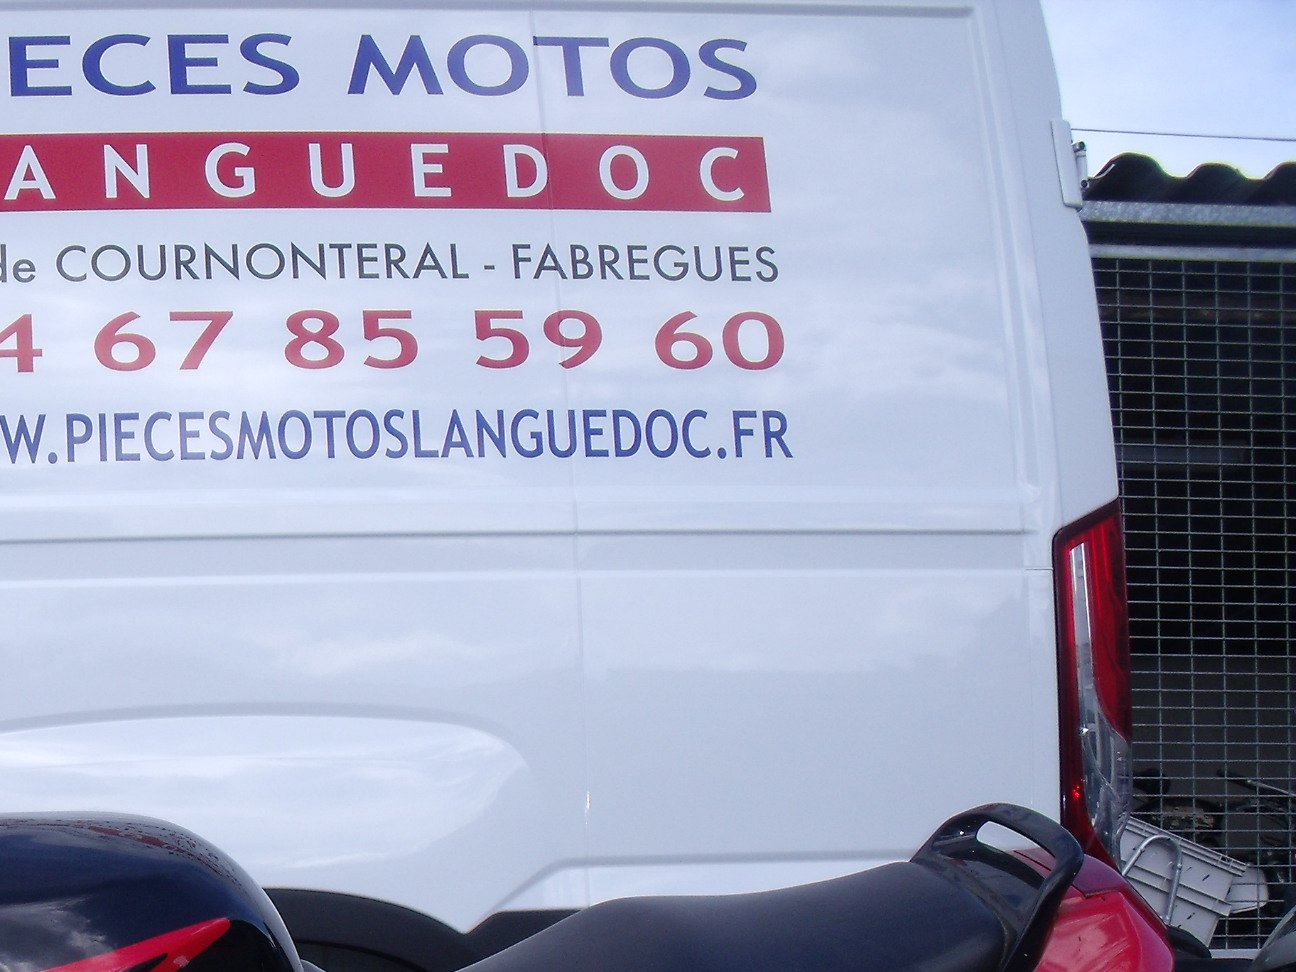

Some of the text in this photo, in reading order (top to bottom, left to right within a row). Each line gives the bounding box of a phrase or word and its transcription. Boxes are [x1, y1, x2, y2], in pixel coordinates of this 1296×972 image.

[348, 34, 757, 100] MOTOS
[56, 242, 469, 282] COURNONTERAL
[512, 243, 778, 282] FABREGUES
[94, 311, 233, 371] 67
[285, 310, 418, 369] 85
[475, 310, 602, 369] 59
[655, 311, 784, 370] 60
